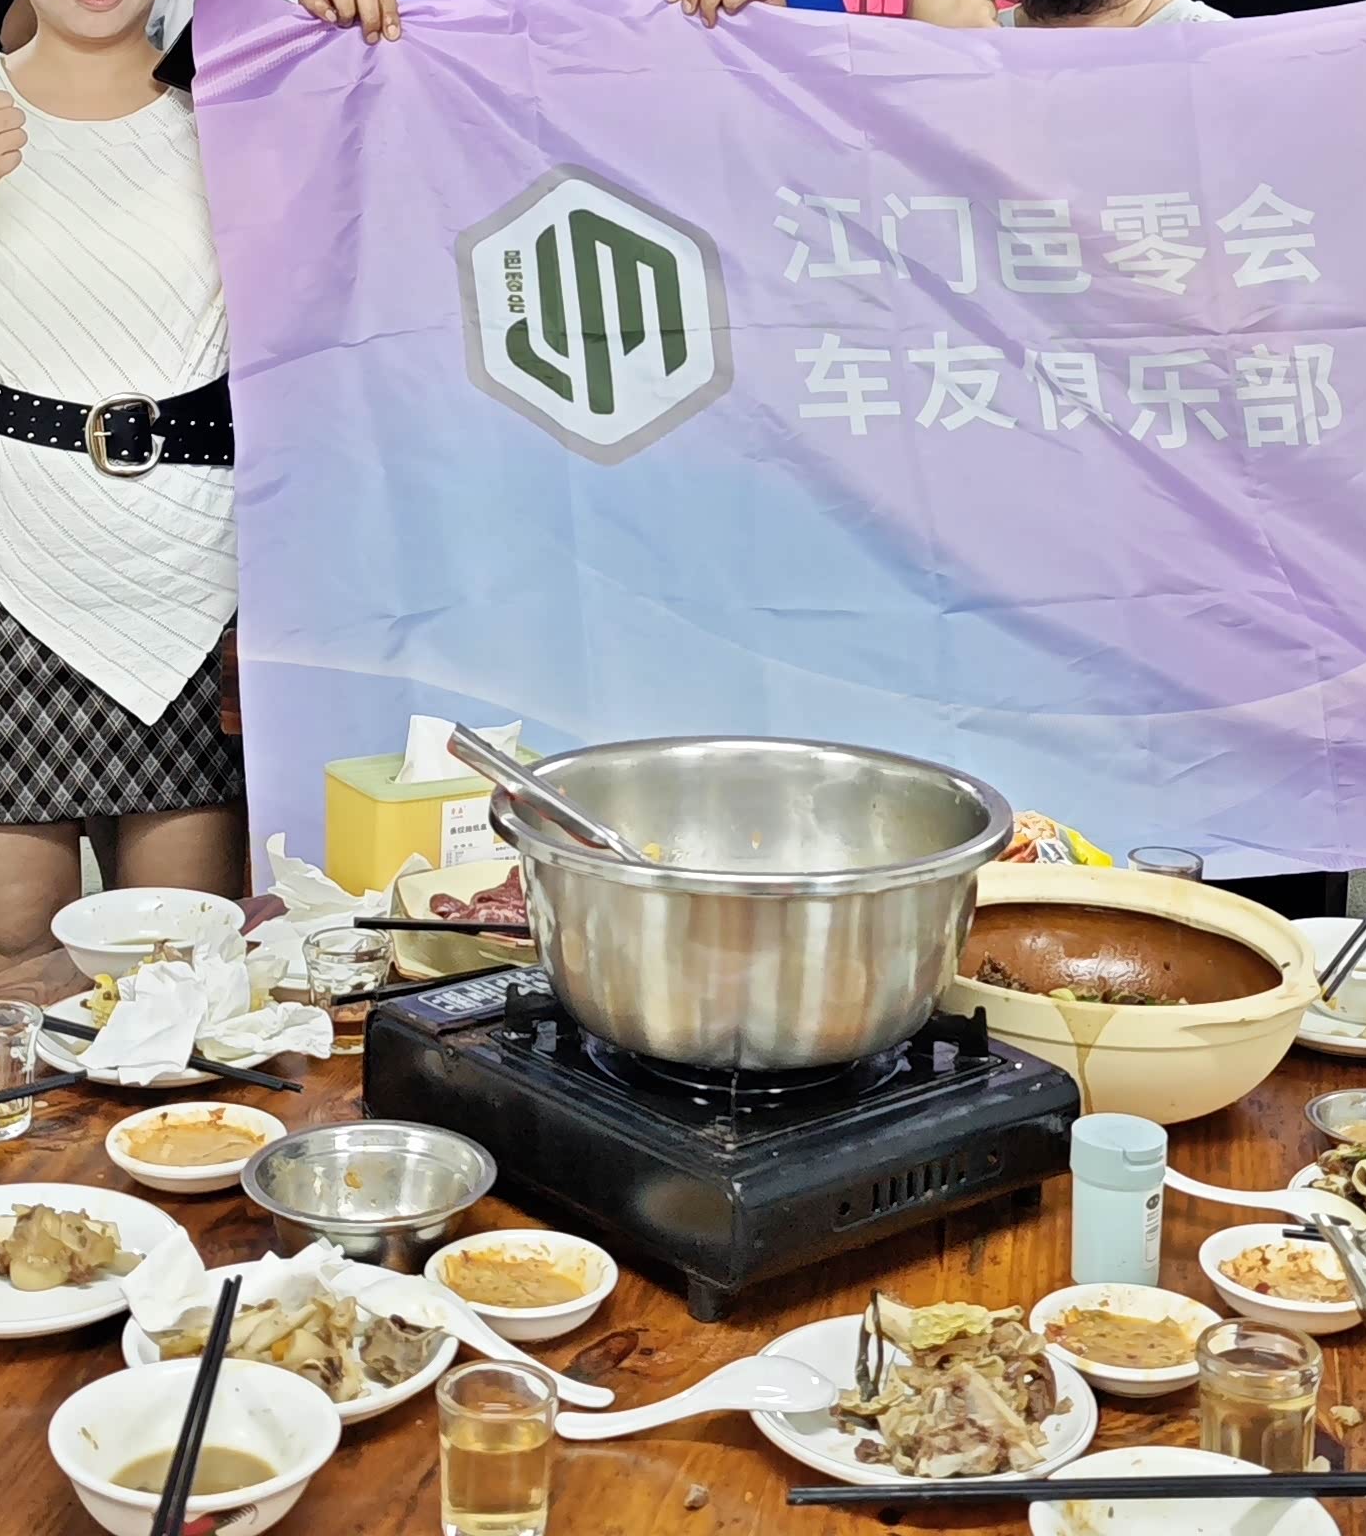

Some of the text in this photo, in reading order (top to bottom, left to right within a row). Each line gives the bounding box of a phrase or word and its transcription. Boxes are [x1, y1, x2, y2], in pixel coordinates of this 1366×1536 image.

[773, 183, 1321, 296] 江门邑零会
[795, 330, 1344, 449] 车友俱乐部
